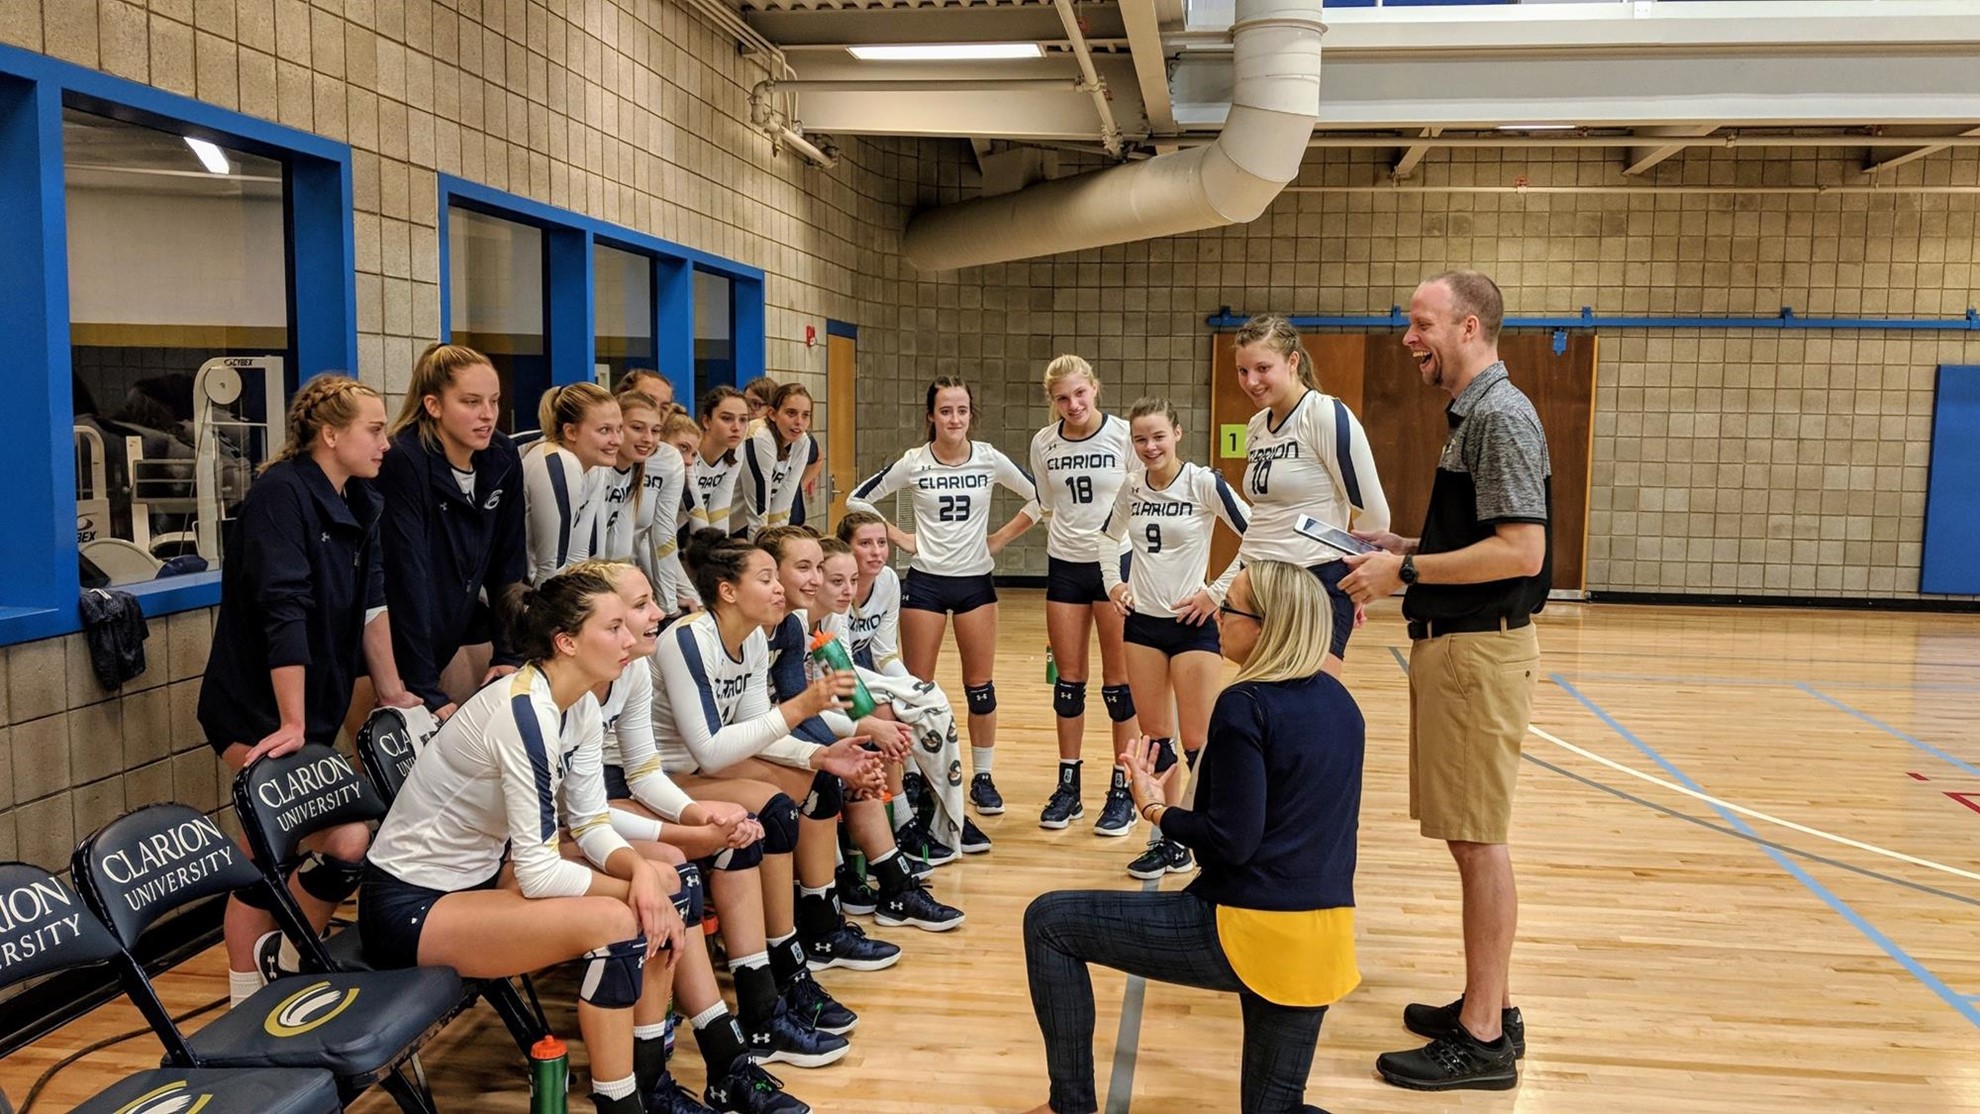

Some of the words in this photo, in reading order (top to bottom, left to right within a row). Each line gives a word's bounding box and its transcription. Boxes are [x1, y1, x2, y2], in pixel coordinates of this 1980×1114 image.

[1229, 433, 1237, 452] 1
[1047, 454, 1116, 471] CLARION
[1252, 460, 1273, 495] 10
[919, 474, 989, 490] CLARION
[1065, 475, 1094, 505] 18
[939, 495, 972, 523] 23
[1145, 523, 1162, 554] 9
[258, 753, 354, 809] CLARION
[276, 781, 362, 832] UNIVERSITY
[102, 815, 224, 884] CLARION
[123, 845, 233, 912] UNIVERSITY
[0, 912, 81, 970] RSITY
